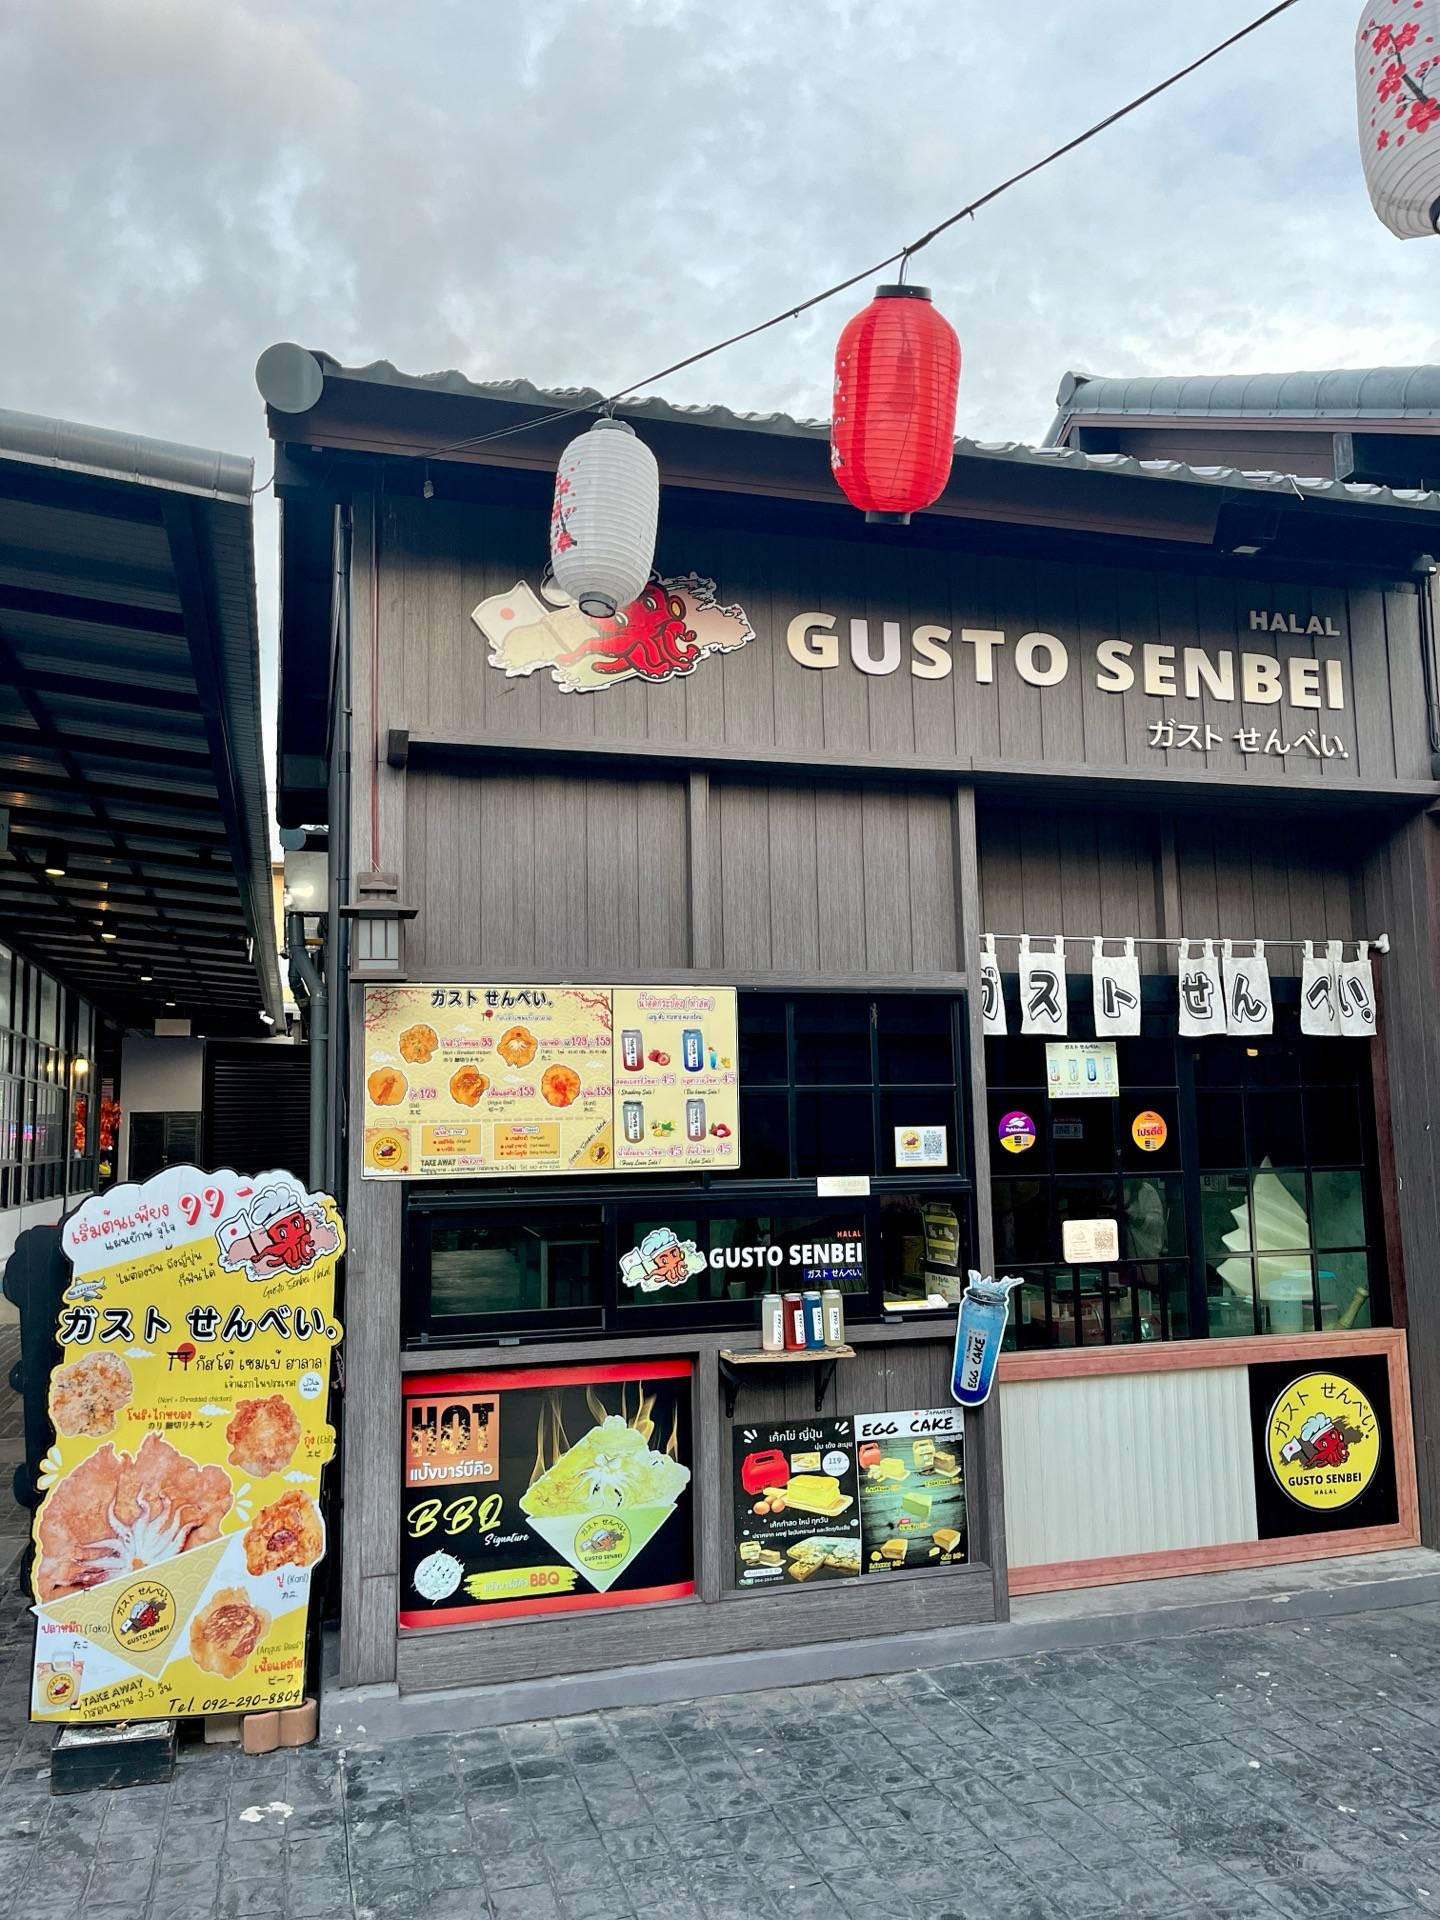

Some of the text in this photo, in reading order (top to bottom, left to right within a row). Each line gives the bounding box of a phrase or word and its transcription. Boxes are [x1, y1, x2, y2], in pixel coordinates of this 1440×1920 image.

[1249, 610, 1340, 636] HALAL
[786, 611, 1345, 709] GUSTO SENBEI
[1149, 718, 1223, 750] ガスト
[431, 989, 478, 1008] ガスト
[72, 1186, 225, 1244] เริ่มต้นเพียง 99
[709, 1243, 863, 1268] GUSTO SENBEI
[61, 1306, 171, 1344] ガスト
[968, 1337, 986, 1389] EGG CAKE
[862, 1416, 954, 1437] EGG CAKE
[1274, 1391, 1309, 1438] ガスト
[411, 1402, 495, 1458] HOT
[1288, 1473, 1362, 1487] GUSTO SENBEI
[407, 1493, 503, 1538] BBQ
[484, 1532, 530, 1547] Signature
[529, 1571, 560, 1588] BBQ
[126, 1624, 170, 1645] GUSTO SENBEI
[81, 1679, 144, 1707] TAKE AWAY
